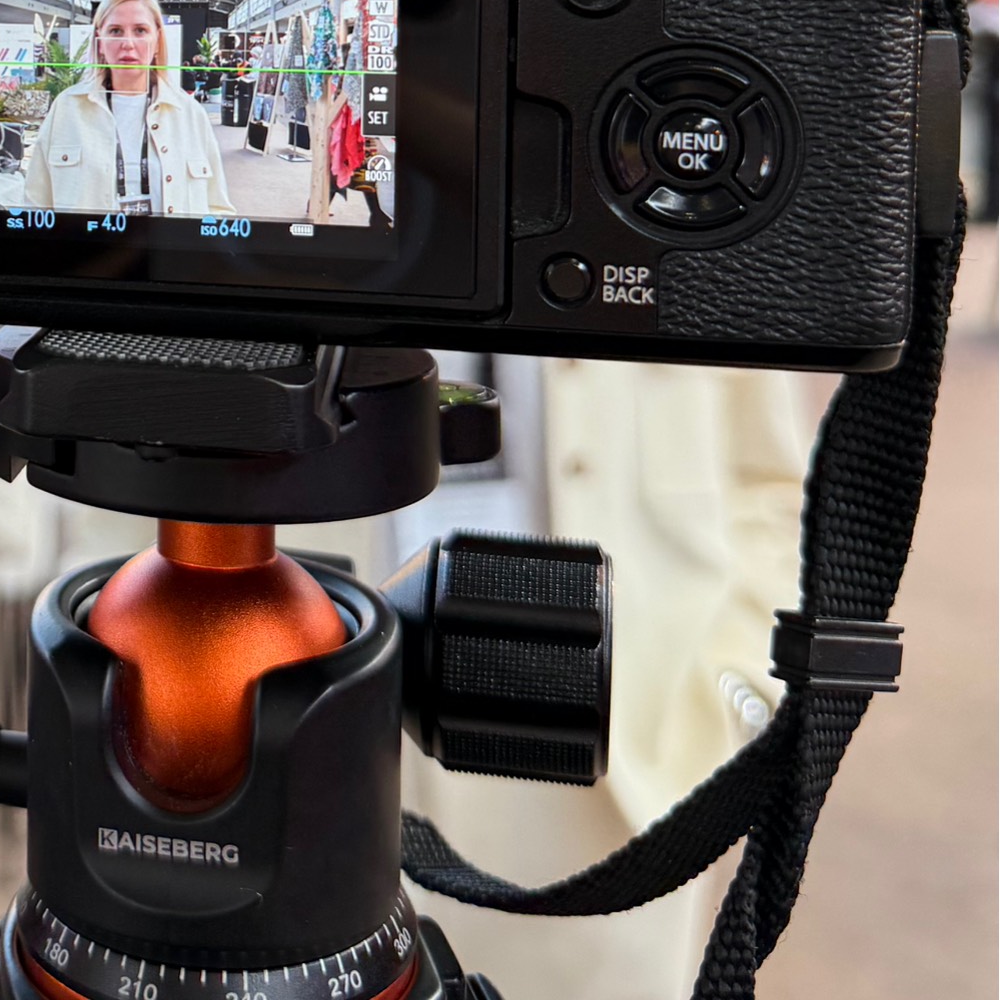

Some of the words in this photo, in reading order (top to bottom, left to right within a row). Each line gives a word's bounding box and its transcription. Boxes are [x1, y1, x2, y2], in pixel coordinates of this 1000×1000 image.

[375, 1, 388, 14] W
[370, 24, 390, 39] STD
[367, 45, 394, 55] DR
[370, 56, 392, 69] 100
[367, 110, 389, 125] SET
[662, 131, 723, 153] MENU
[678, 152, 710, 172] OK
[365, 170, 392, 181] BOOST
[26, 210, 55, 228] 100
[101, 212, 126, 232] 4.0
[200, 225, 218, 236] ISO
[219, 218, 251, 237] 640
[603, 265, 650, 285] DISP
[603, 285, 654, 304] BACK
[98, 827, 240, 863] KAISEBERG
[393, 926, 412, 957] 300
[43, 937, 69, 967] 180
[118, 975, 158, 1000] 210
[328, 969, 362, 998] 270
